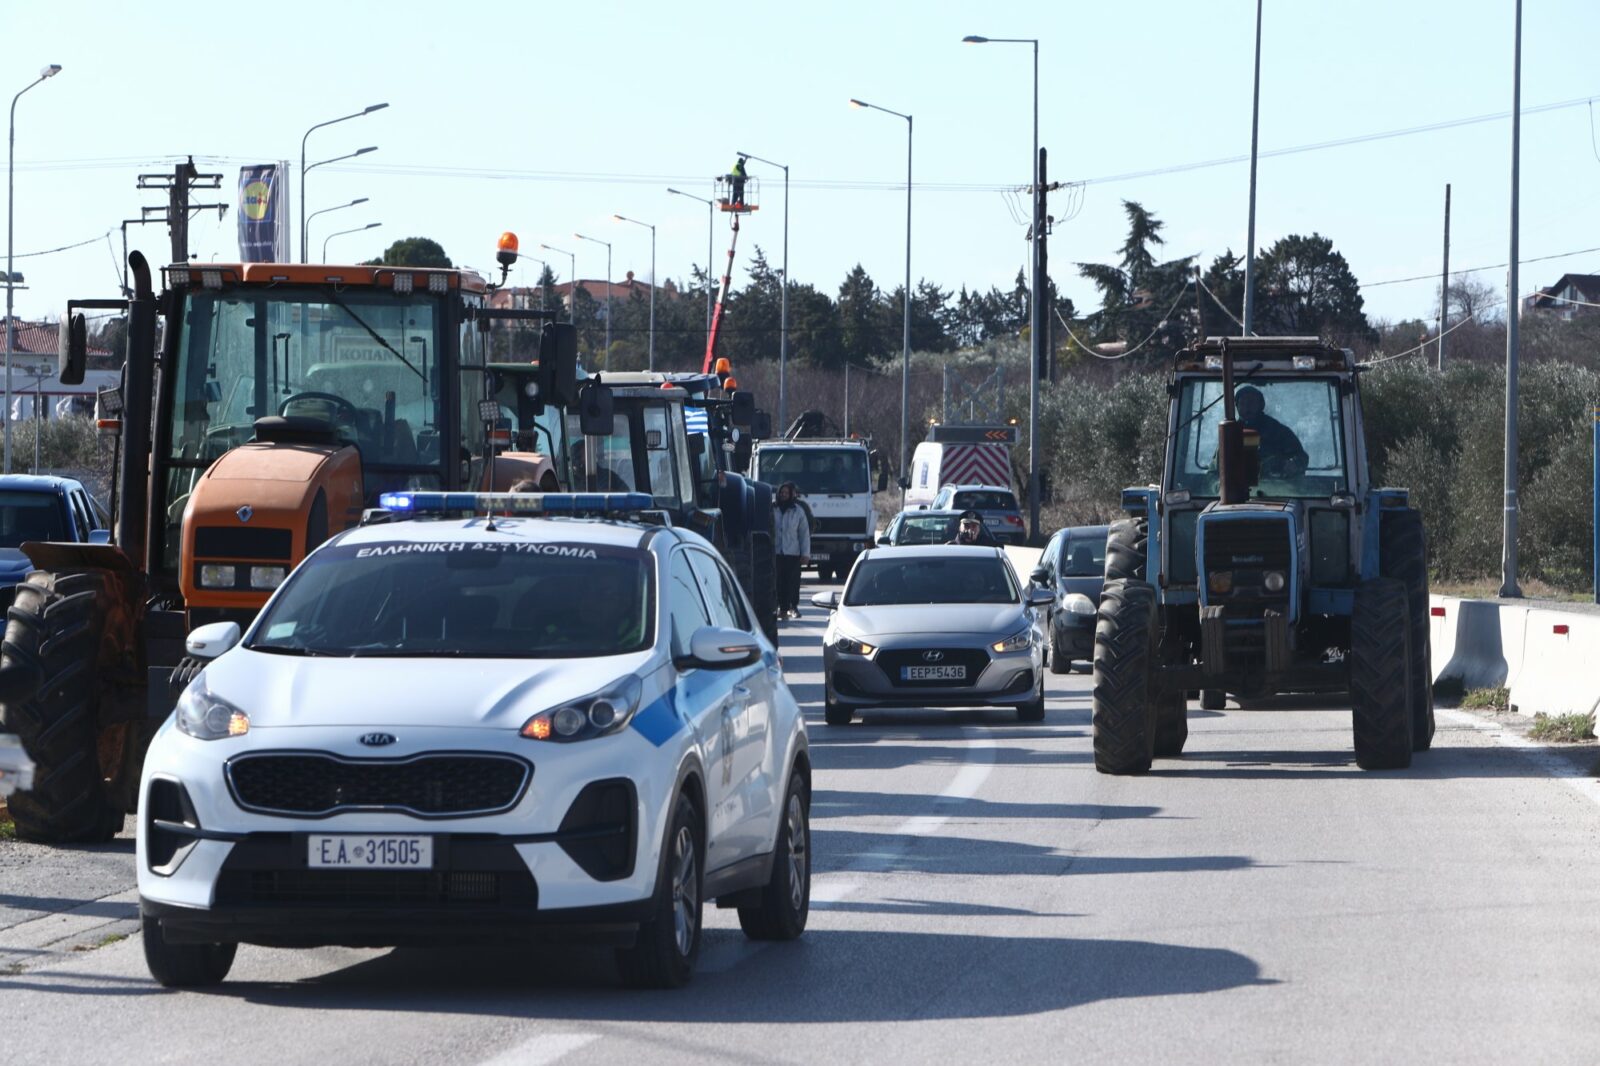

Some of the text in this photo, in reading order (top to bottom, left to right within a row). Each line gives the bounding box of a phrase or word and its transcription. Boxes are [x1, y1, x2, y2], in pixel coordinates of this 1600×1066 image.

[356, 542, 598, 559] ΕΛΛΗΝΙΚΗ ΑΣΤΥΝΟΜΙΑ
[366, 839, 420, 865] 31505
